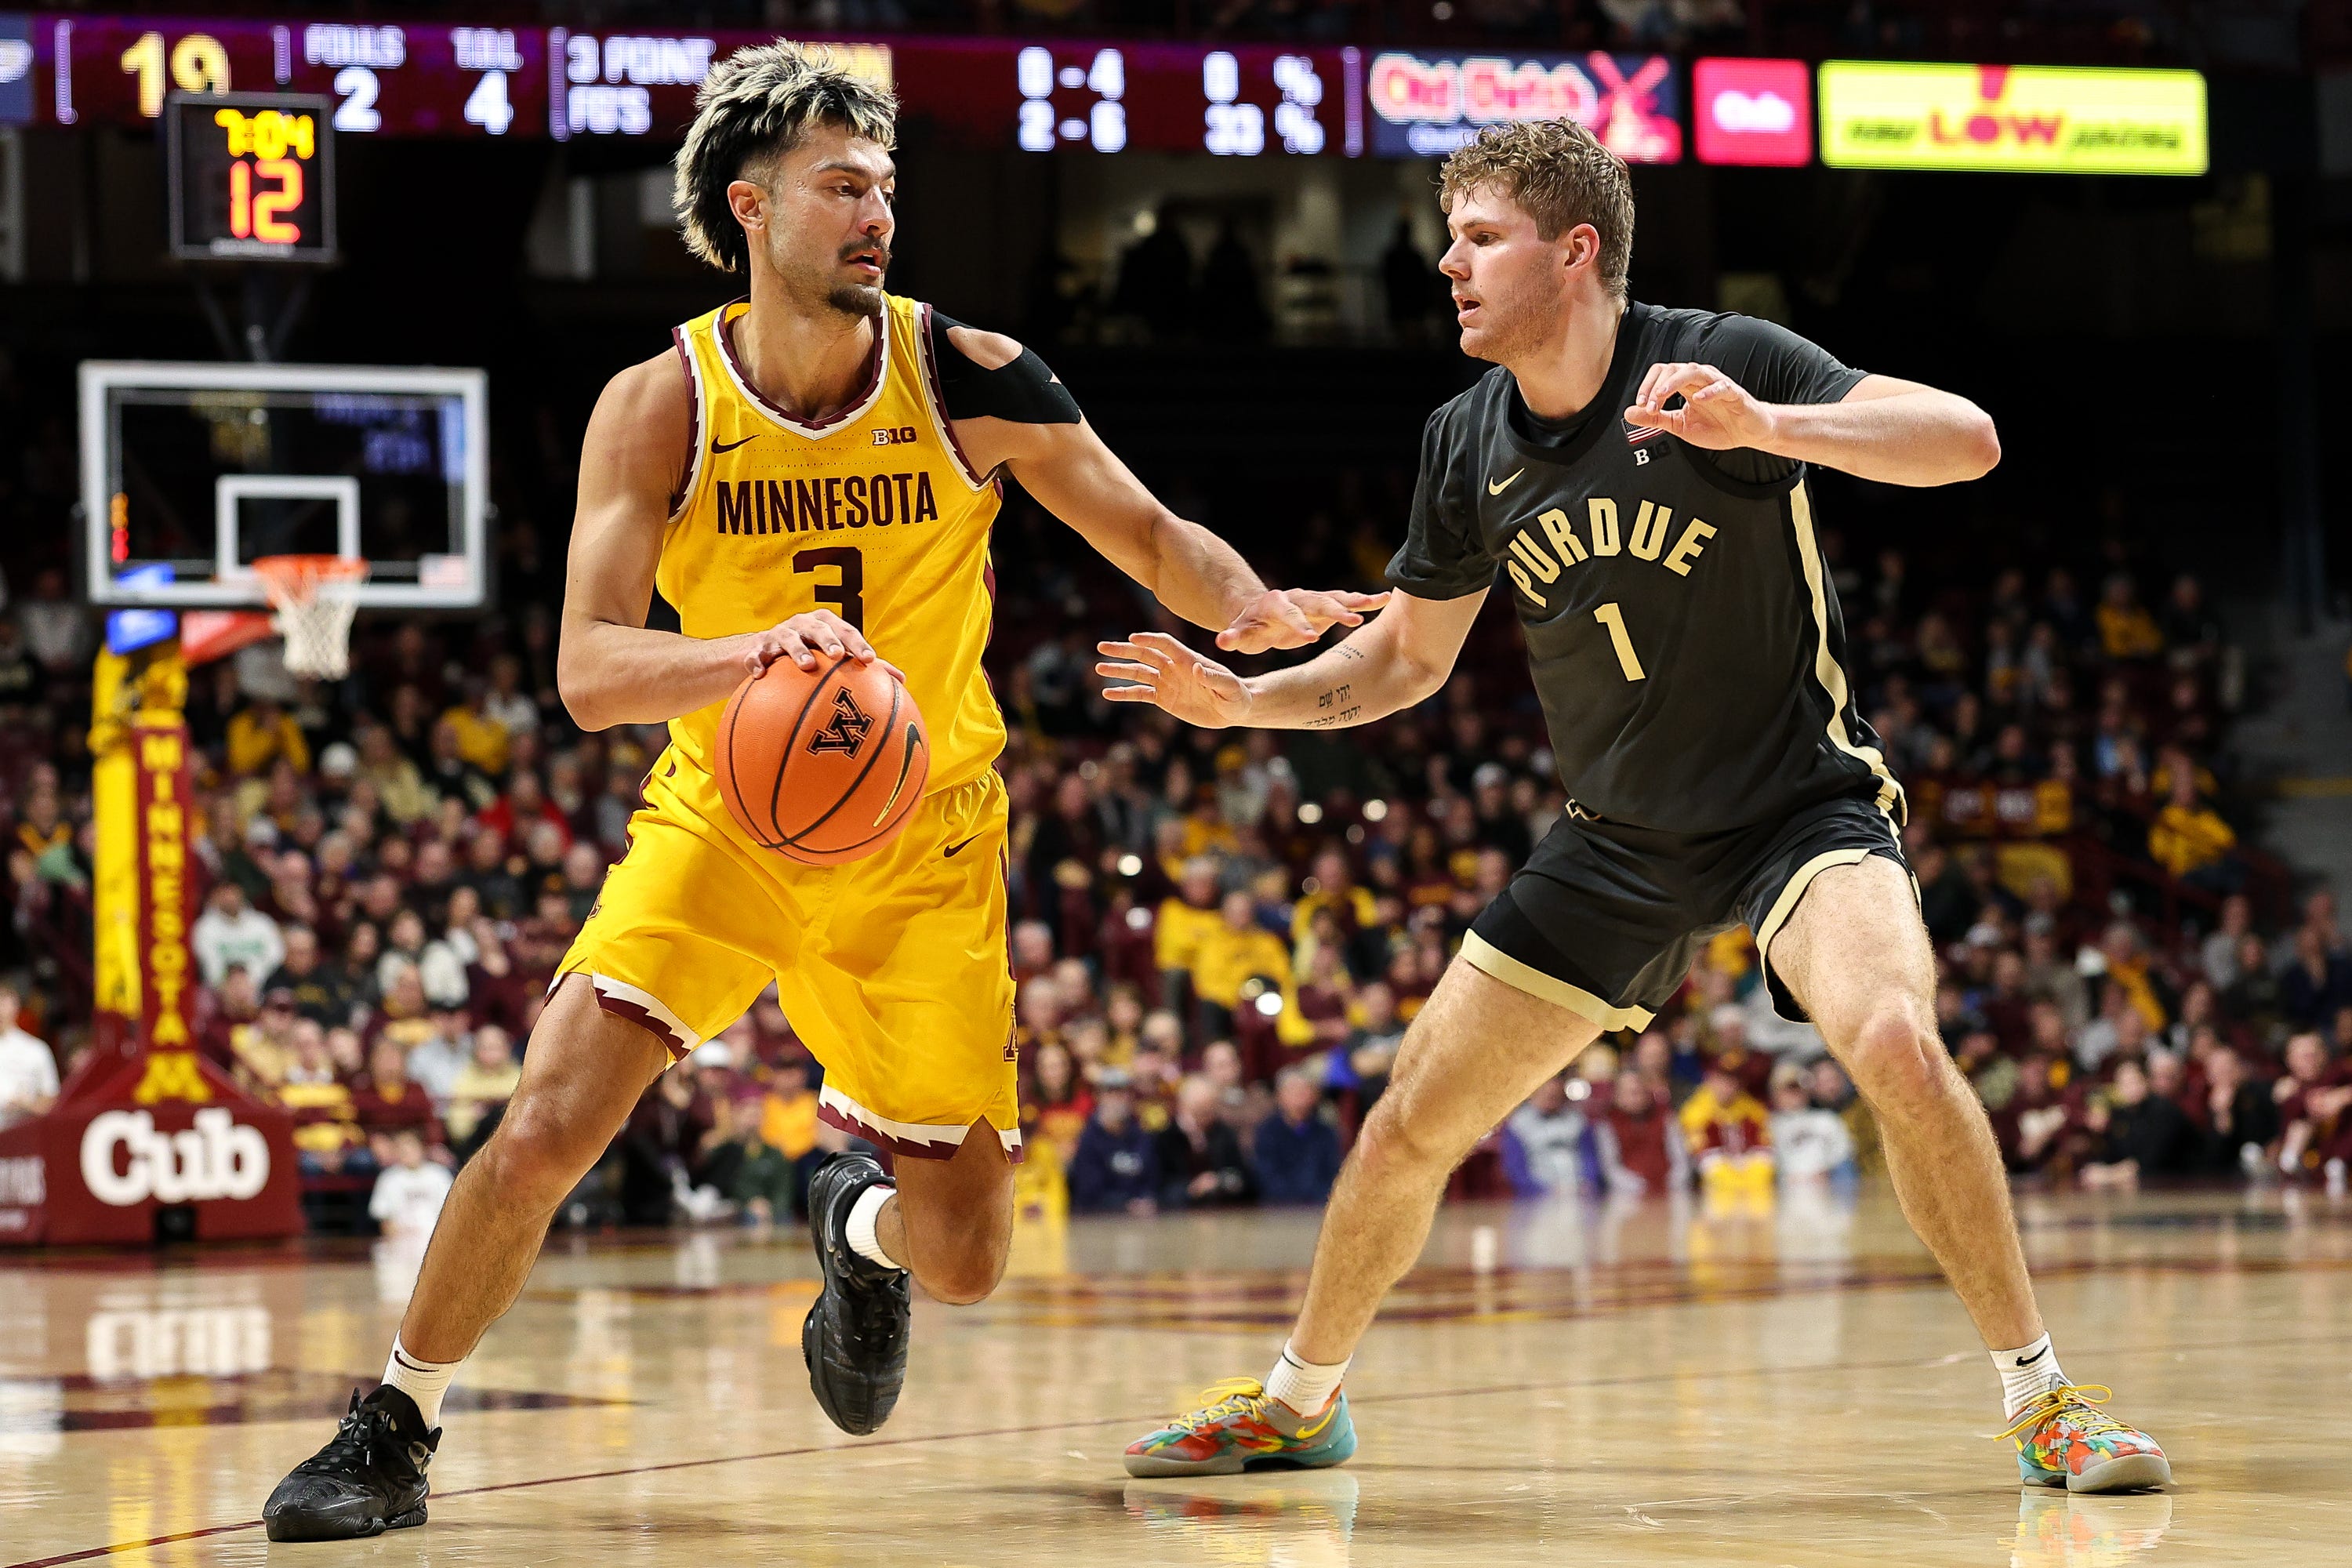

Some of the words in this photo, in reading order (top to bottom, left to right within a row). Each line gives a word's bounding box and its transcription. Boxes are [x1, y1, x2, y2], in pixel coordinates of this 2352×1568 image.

[120, 31, 231, 118] 19
[333, 67, 382, 132] 2
[465, 69, 514, 134] 4
[215, 109, 315, 159] 7:04
[1928, 112, 2063, 148] LOW
[230, 159, 303, 244] 12
[717, 471, 938, 535] MINNESOTA
[1507, 498, 1718, 608] PURDUE
[792, 546, 864, 640] 3
[1593, 602, 1646, 682] 1
[806, 686, 875, 760] M
[79, 1107, 271, 1207] Cub
